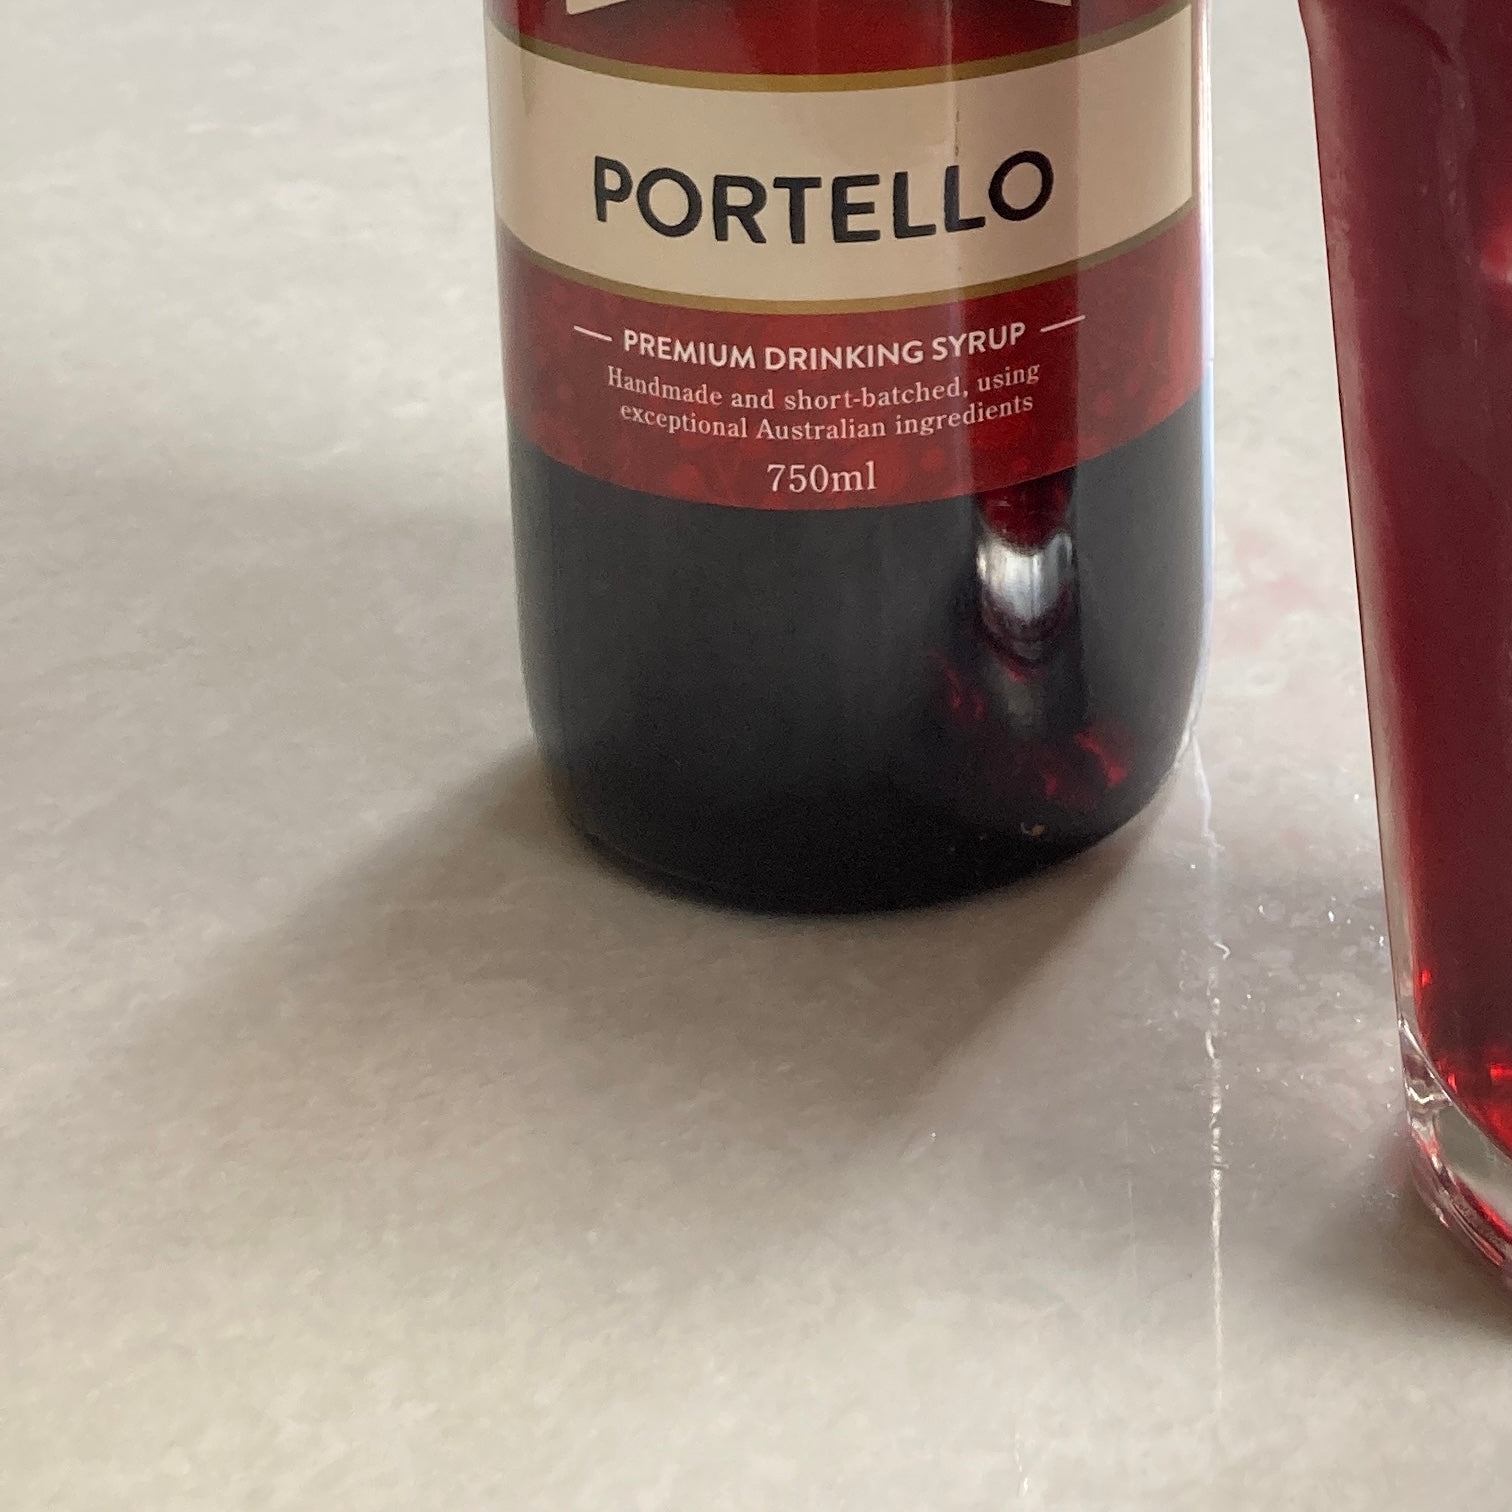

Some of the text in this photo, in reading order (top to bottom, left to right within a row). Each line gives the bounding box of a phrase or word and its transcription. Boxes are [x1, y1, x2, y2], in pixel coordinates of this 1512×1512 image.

[594, 150, 1054, 244] PORTELLO
[623, 322, 1026, 371] PREMIUM DRINKING SYRUP
[607, 360, 1041, 411] Handmade and short-batched, using
[620, 393, 1034, 440] exceptional Australian ingredients
[766, 461, 876, 494] 750ml
